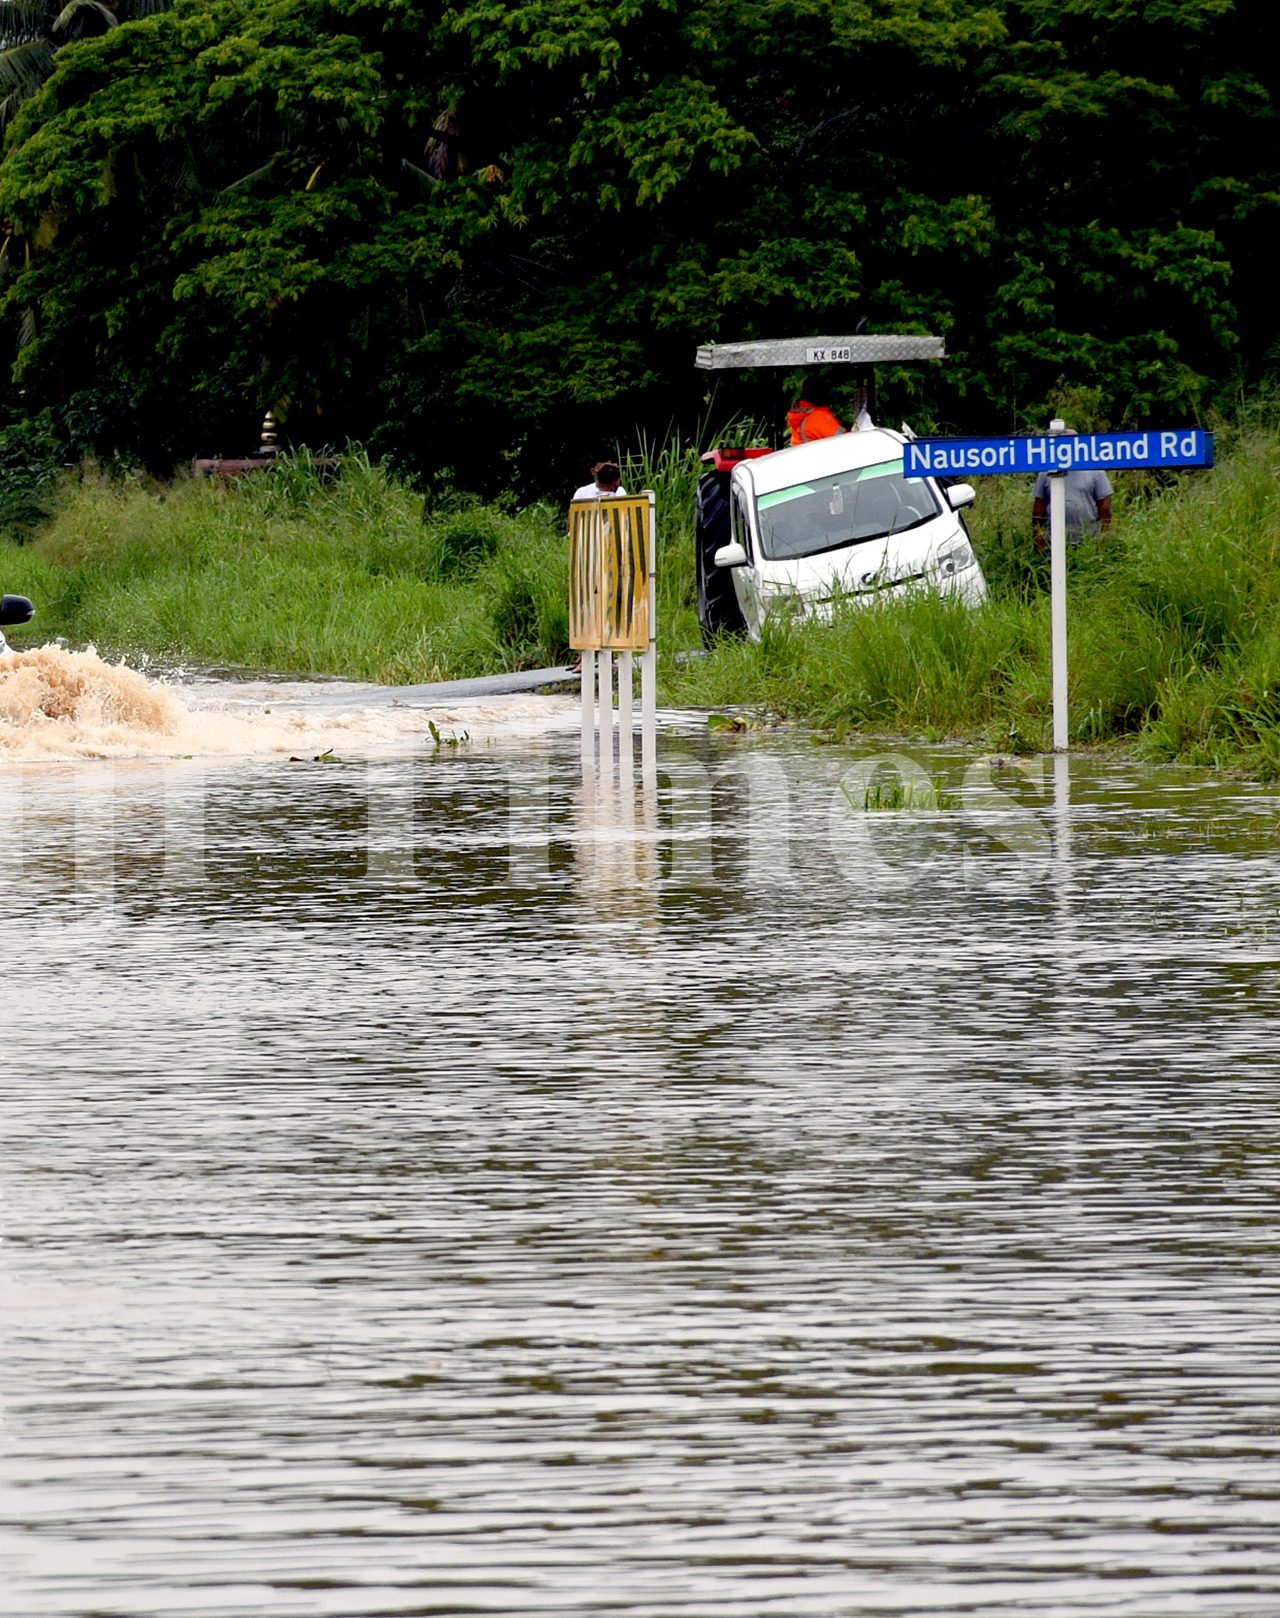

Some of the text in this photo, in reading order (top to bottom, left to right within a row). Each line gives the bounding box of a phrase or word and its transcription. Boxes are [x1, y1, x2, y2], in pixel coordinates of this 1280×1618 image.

[813, 349, 850, 361] KX 848
[910, 431, 1197, 470] Nausori Highland Rd
